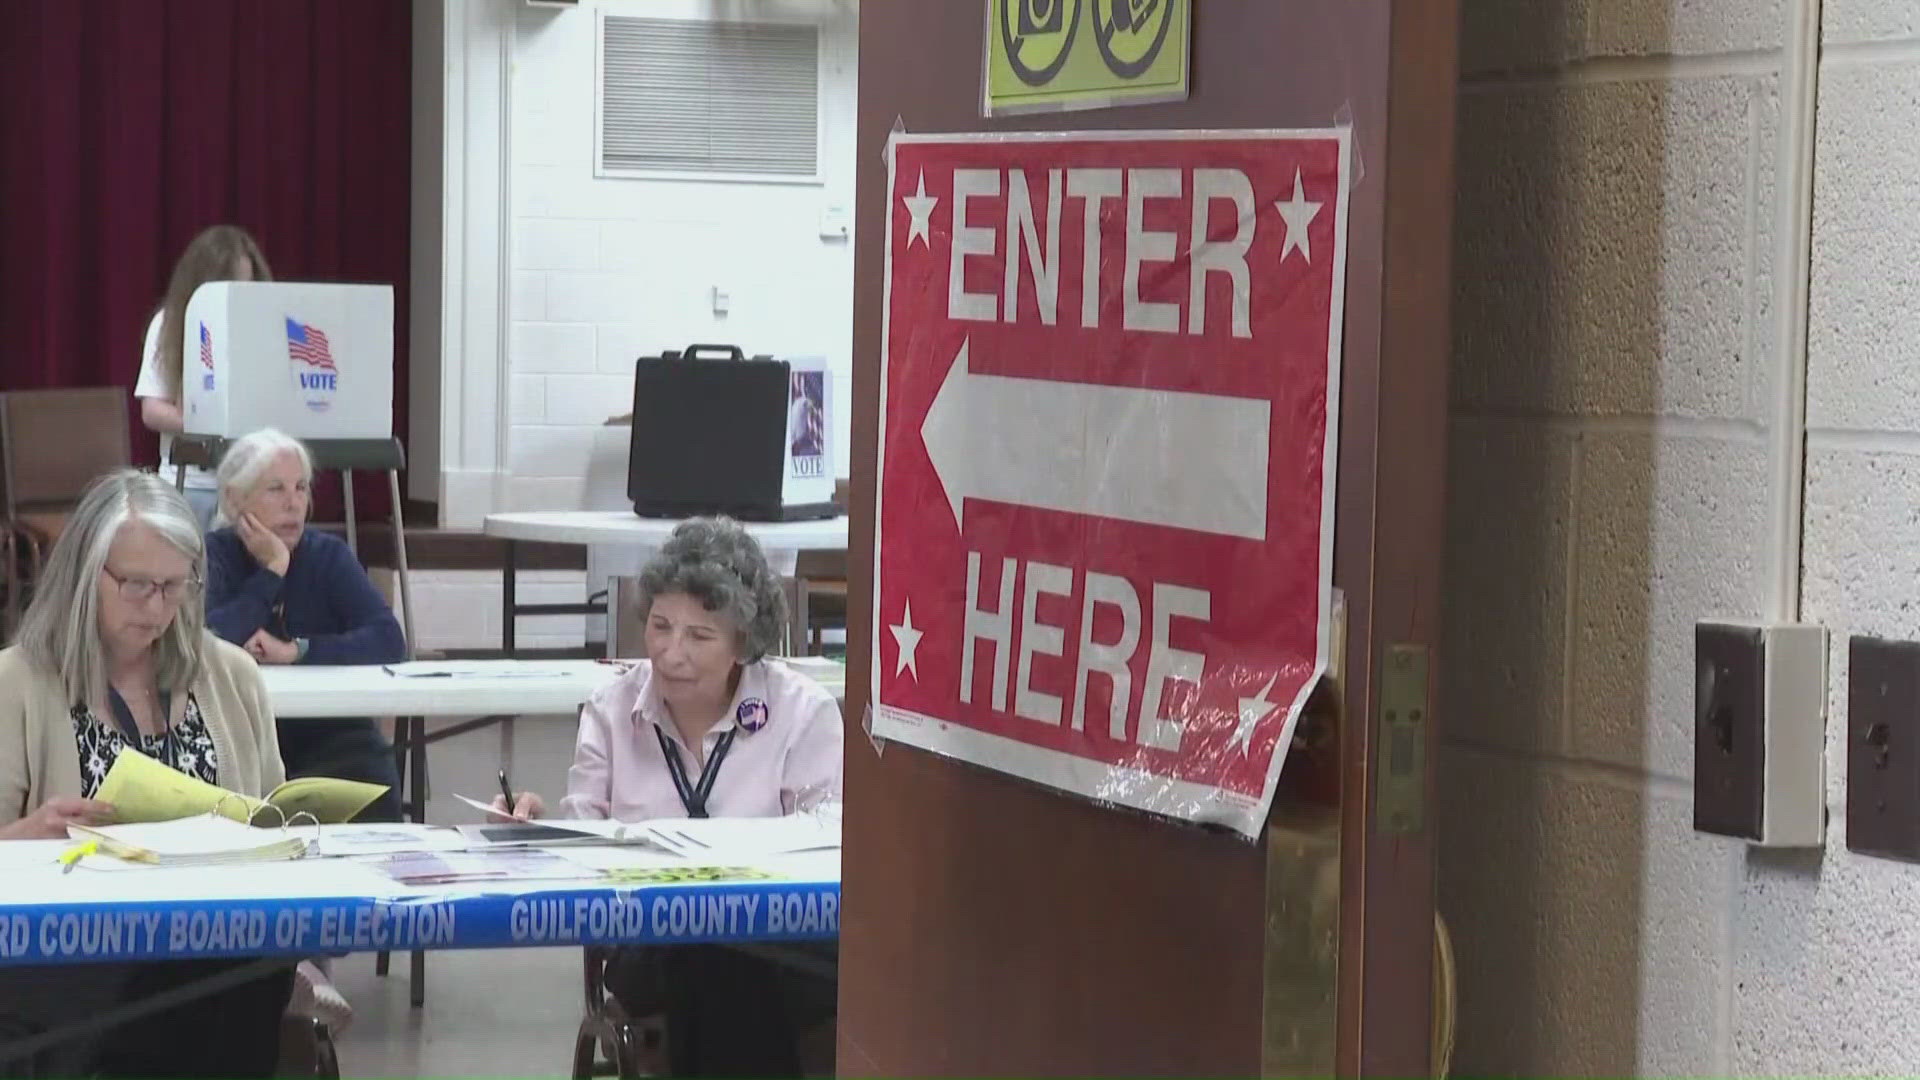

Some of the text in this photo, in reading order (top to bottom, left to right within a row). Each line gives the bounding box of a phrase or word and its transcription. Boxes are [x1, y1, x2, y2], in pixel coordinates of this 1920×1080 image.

[948, 168, 1256, 339] ENTER
[300, 373, 337, 391] VOTE
[793, 456, 823, 475] VOTE
[960, 551, 1212, 752] HERE
[39, 911, 161, 956] COUNTY
[169, 909, 267, 952] BOARD
[275, 908, 313, 947] OF
[319, 902, 456, 945] ELECTION
[510, 892, 840, 941] GUILFORD COUNTY BOAR
